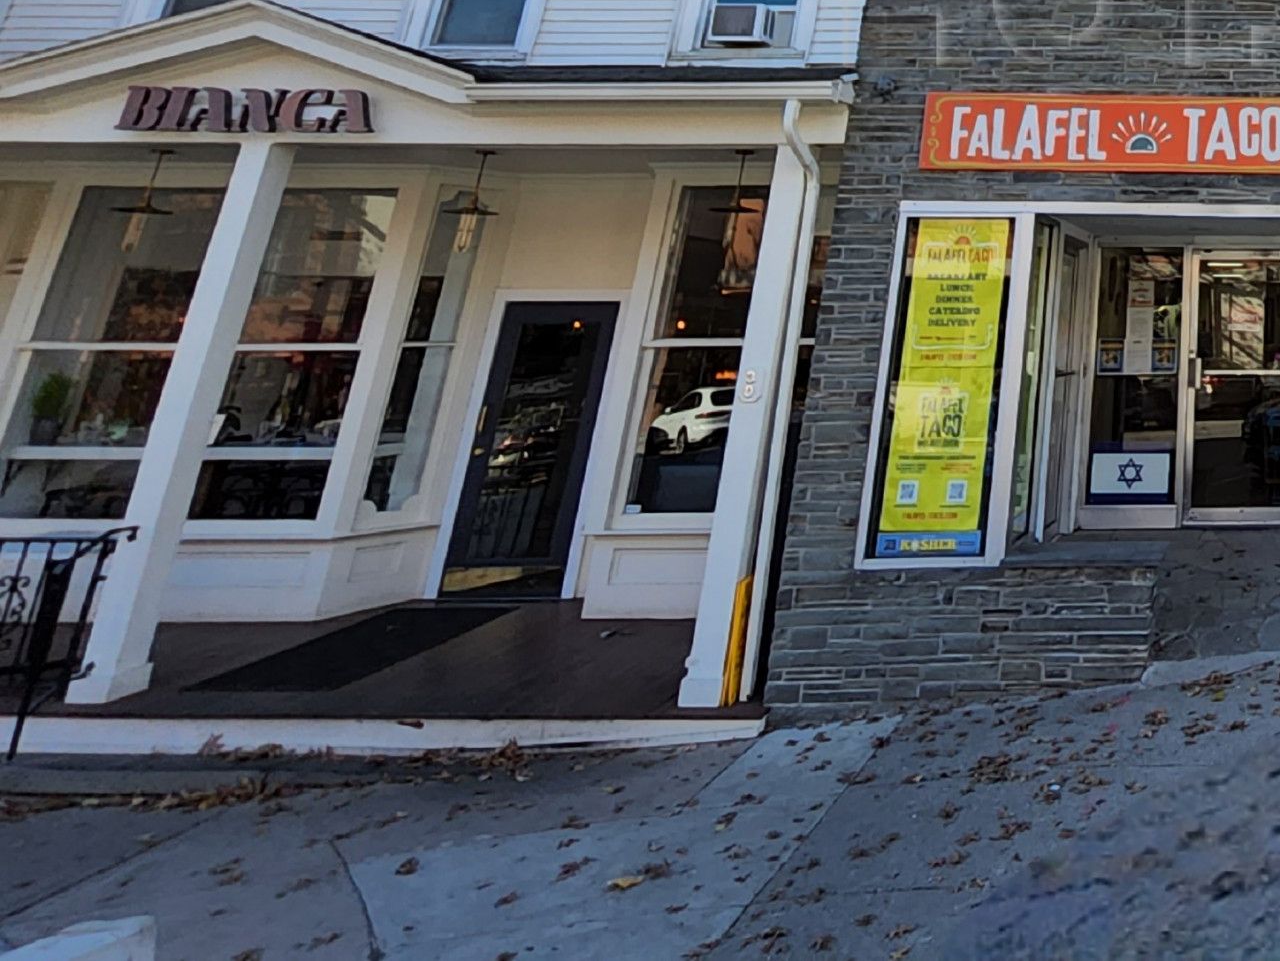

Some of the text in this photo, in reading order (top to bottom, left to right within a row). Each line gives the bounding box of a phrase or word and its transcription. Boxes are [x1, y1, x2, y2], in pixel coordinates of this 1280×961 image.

[114, 85, 375, 133] BIANCA
[928, 306, 981, 315] CATERING
[928, 317, 977, 327] DELIVERY
[920, 413, 963, 438] TACO
